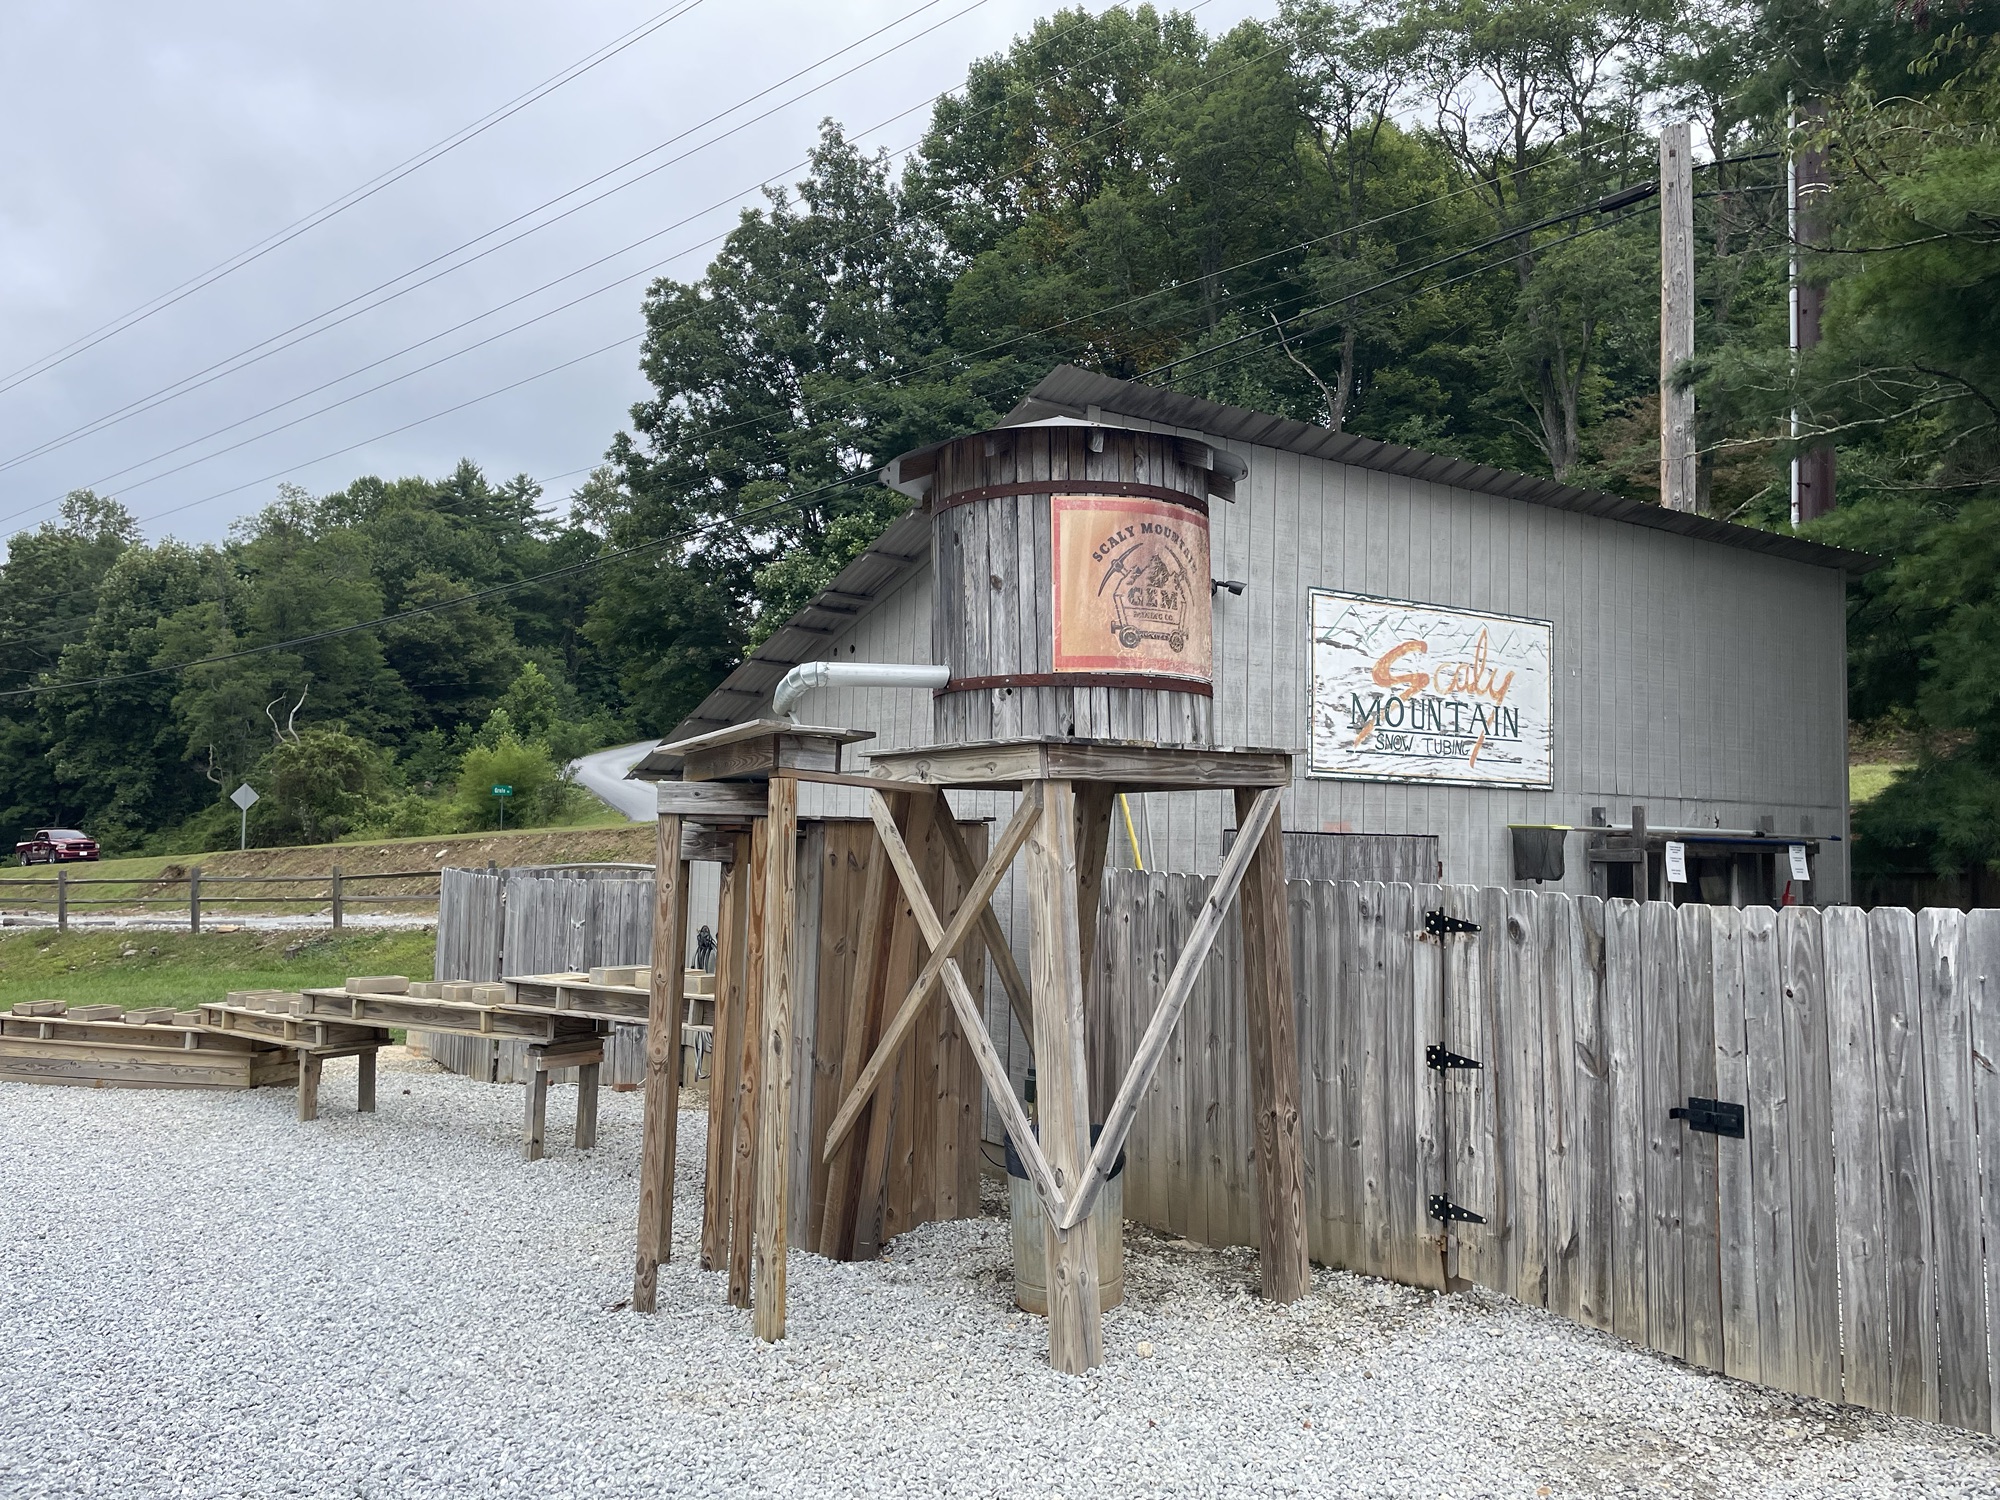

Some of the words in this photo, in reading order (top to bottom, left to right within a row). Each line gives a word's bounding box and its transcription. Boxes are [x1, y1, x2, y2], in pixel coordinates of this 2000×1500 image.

[1092, 525, 1134, 562] SCALY
[1141, 523, 1198, 574] MOUNTAIN
[1127, 587, 1178, 611] GEM
[1350, 692, 1519, 738] MOUNTAIN
[1375, 733, 1414, 752] SNOW
[1423, 738, 1470, 756] TUBING
